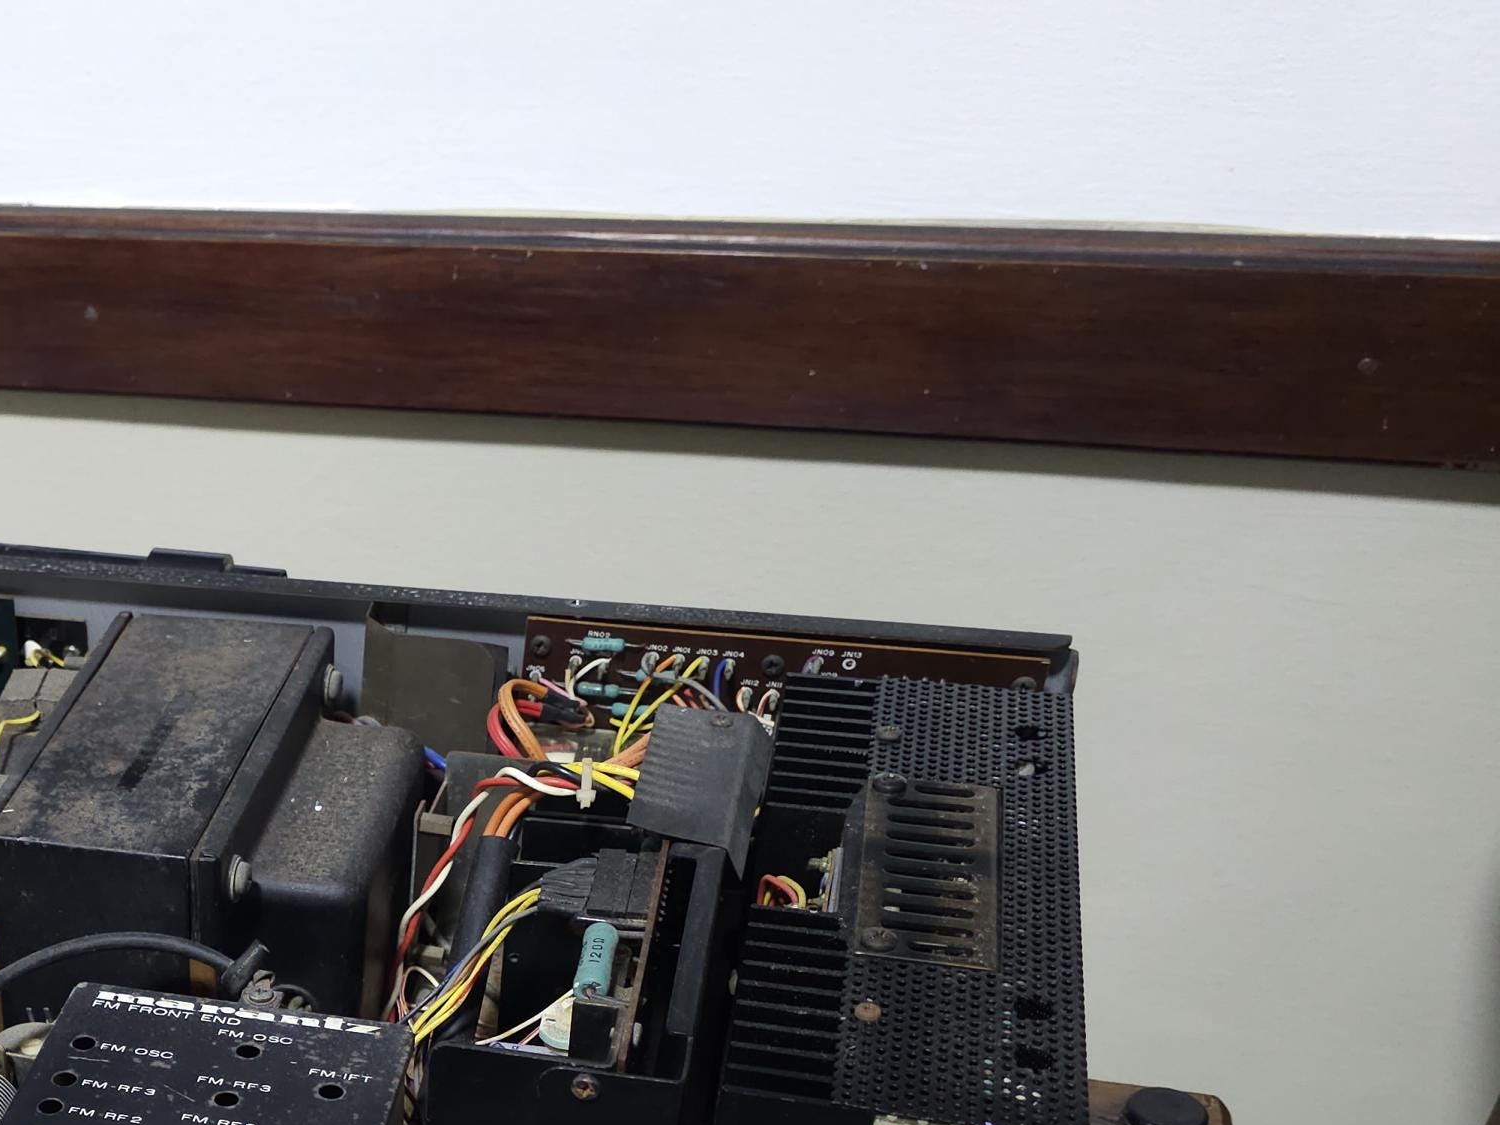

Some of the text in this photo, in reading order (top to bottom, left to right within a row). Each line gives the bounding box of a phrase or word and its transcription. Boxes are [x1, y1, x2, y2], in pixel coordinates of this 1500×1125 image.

[92, 999, 241, 1026] FM FRONT END
[95, 988, 382, 1035] marantz
[308, 1067, 373, 1084] FM-IFT
